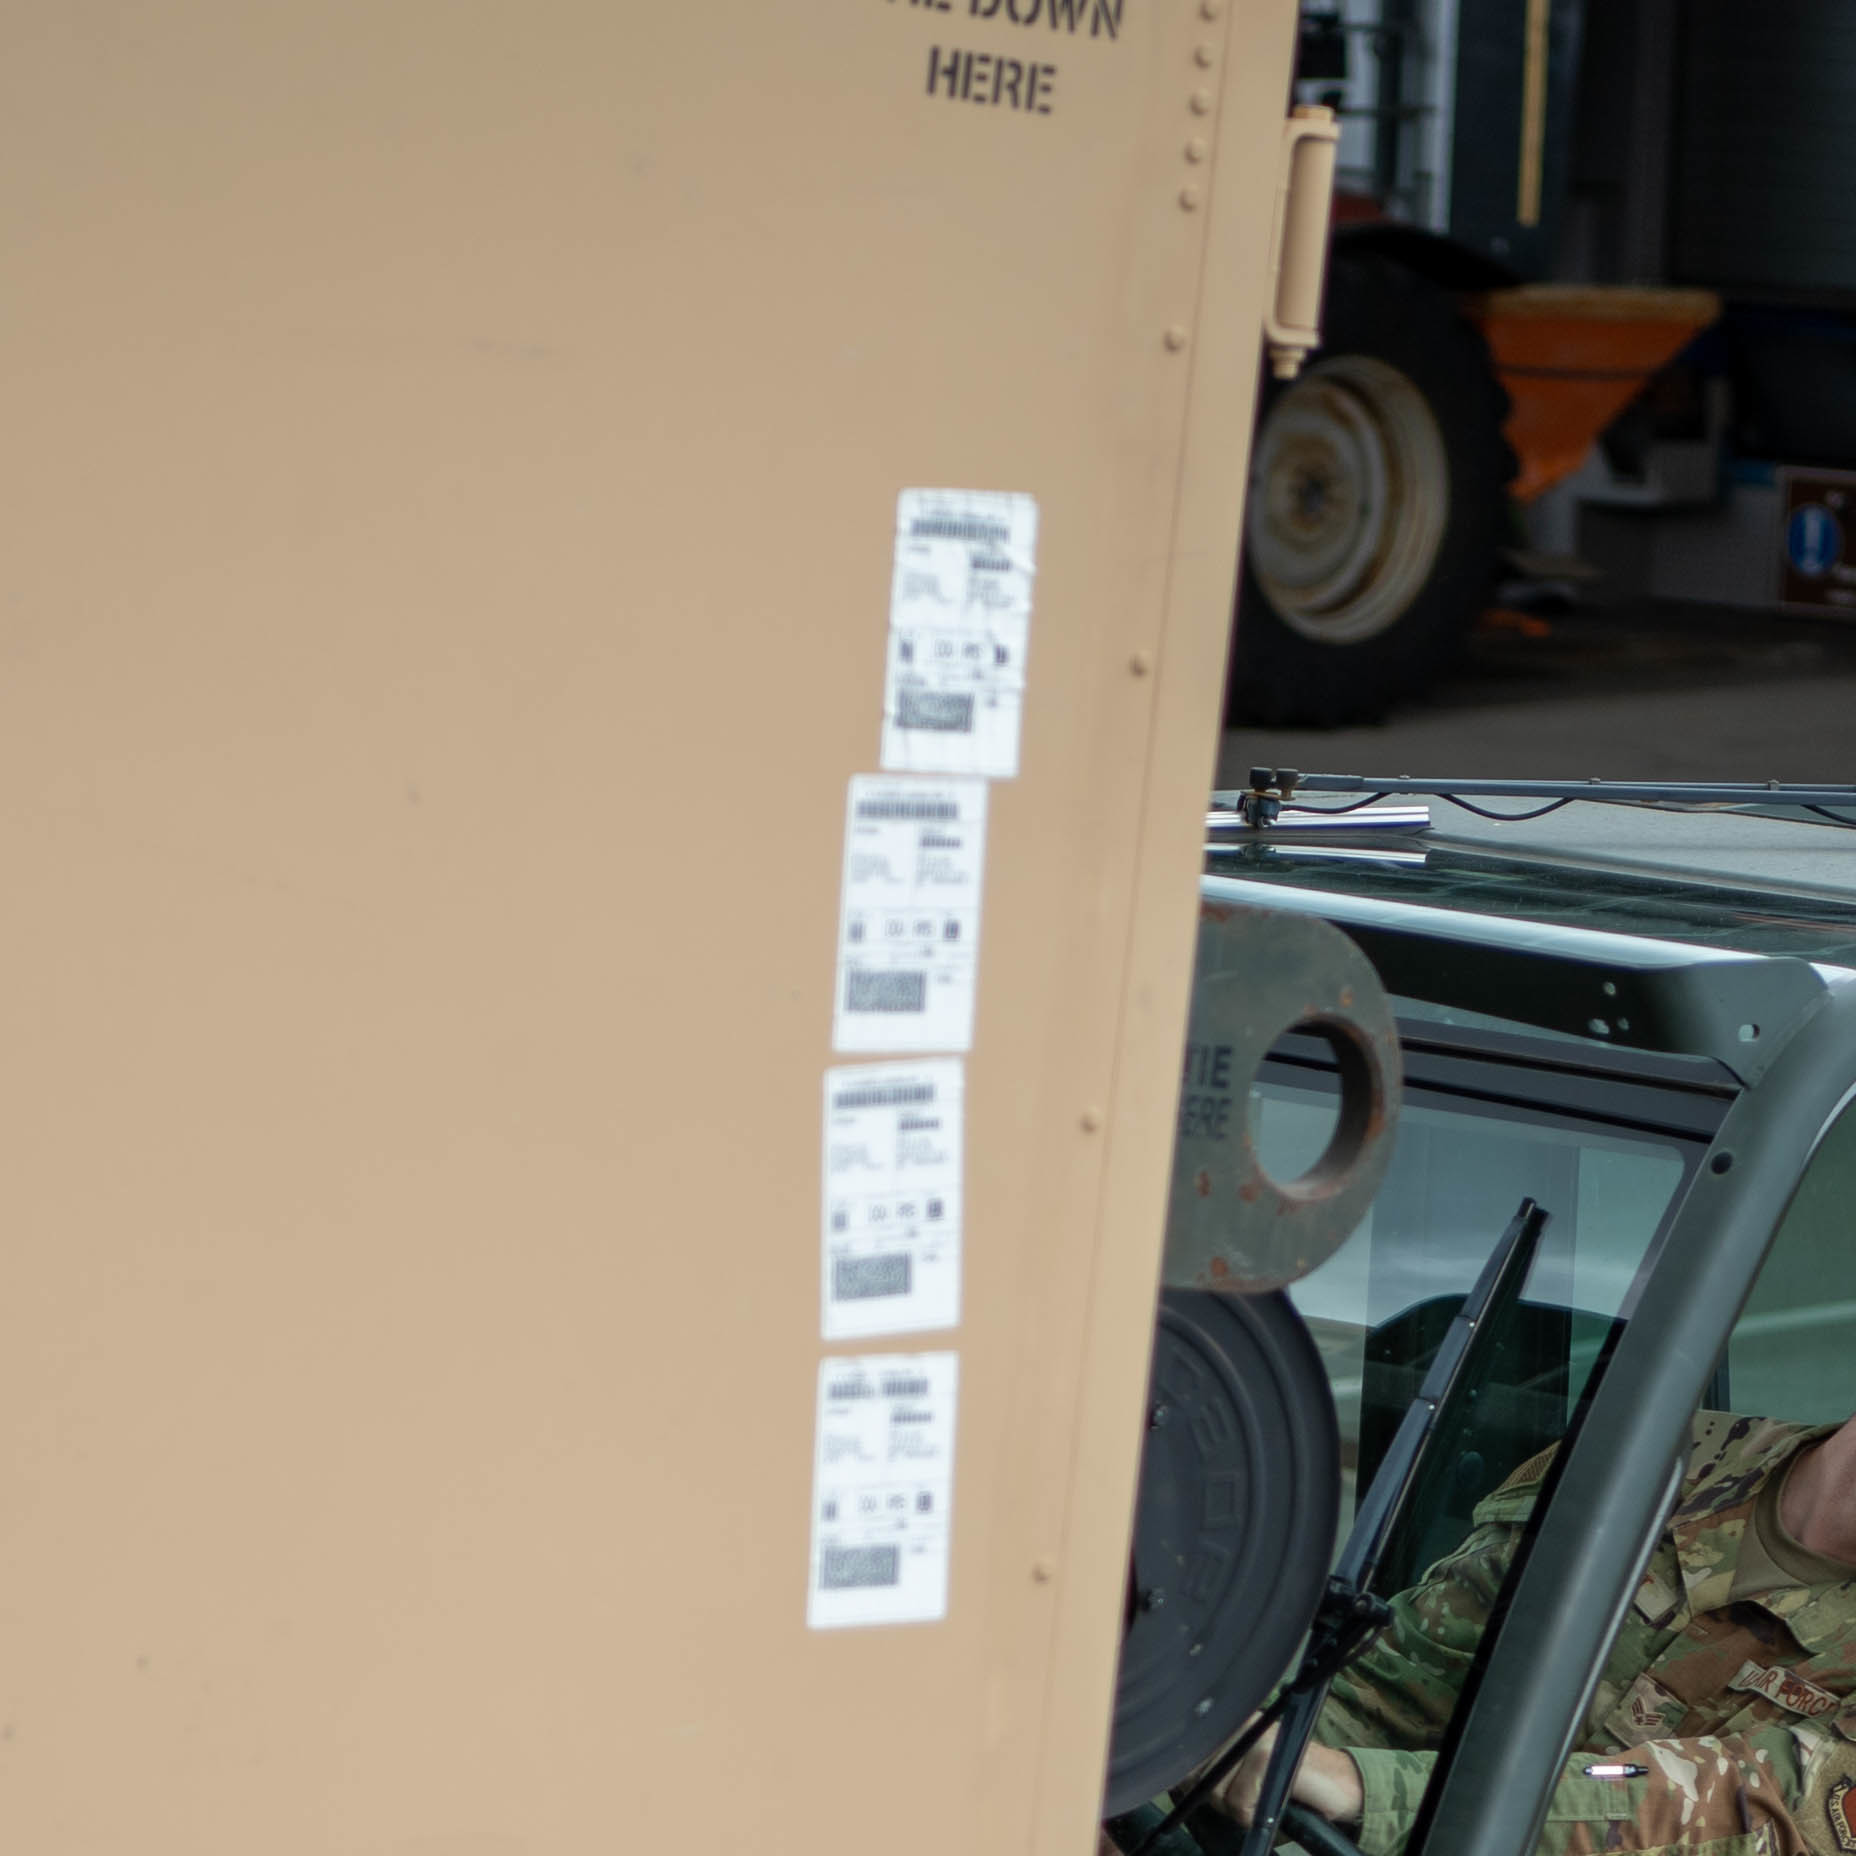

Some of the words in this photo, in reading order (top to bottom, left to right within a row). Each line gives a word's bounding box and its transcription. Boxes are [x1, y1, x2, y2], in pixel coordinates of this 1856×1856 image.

[926, 44, 1057, 115] HERE
[1184, 1095, 1232, 1142] ERE
[1775, 1680, 1836, 1716] FORC
